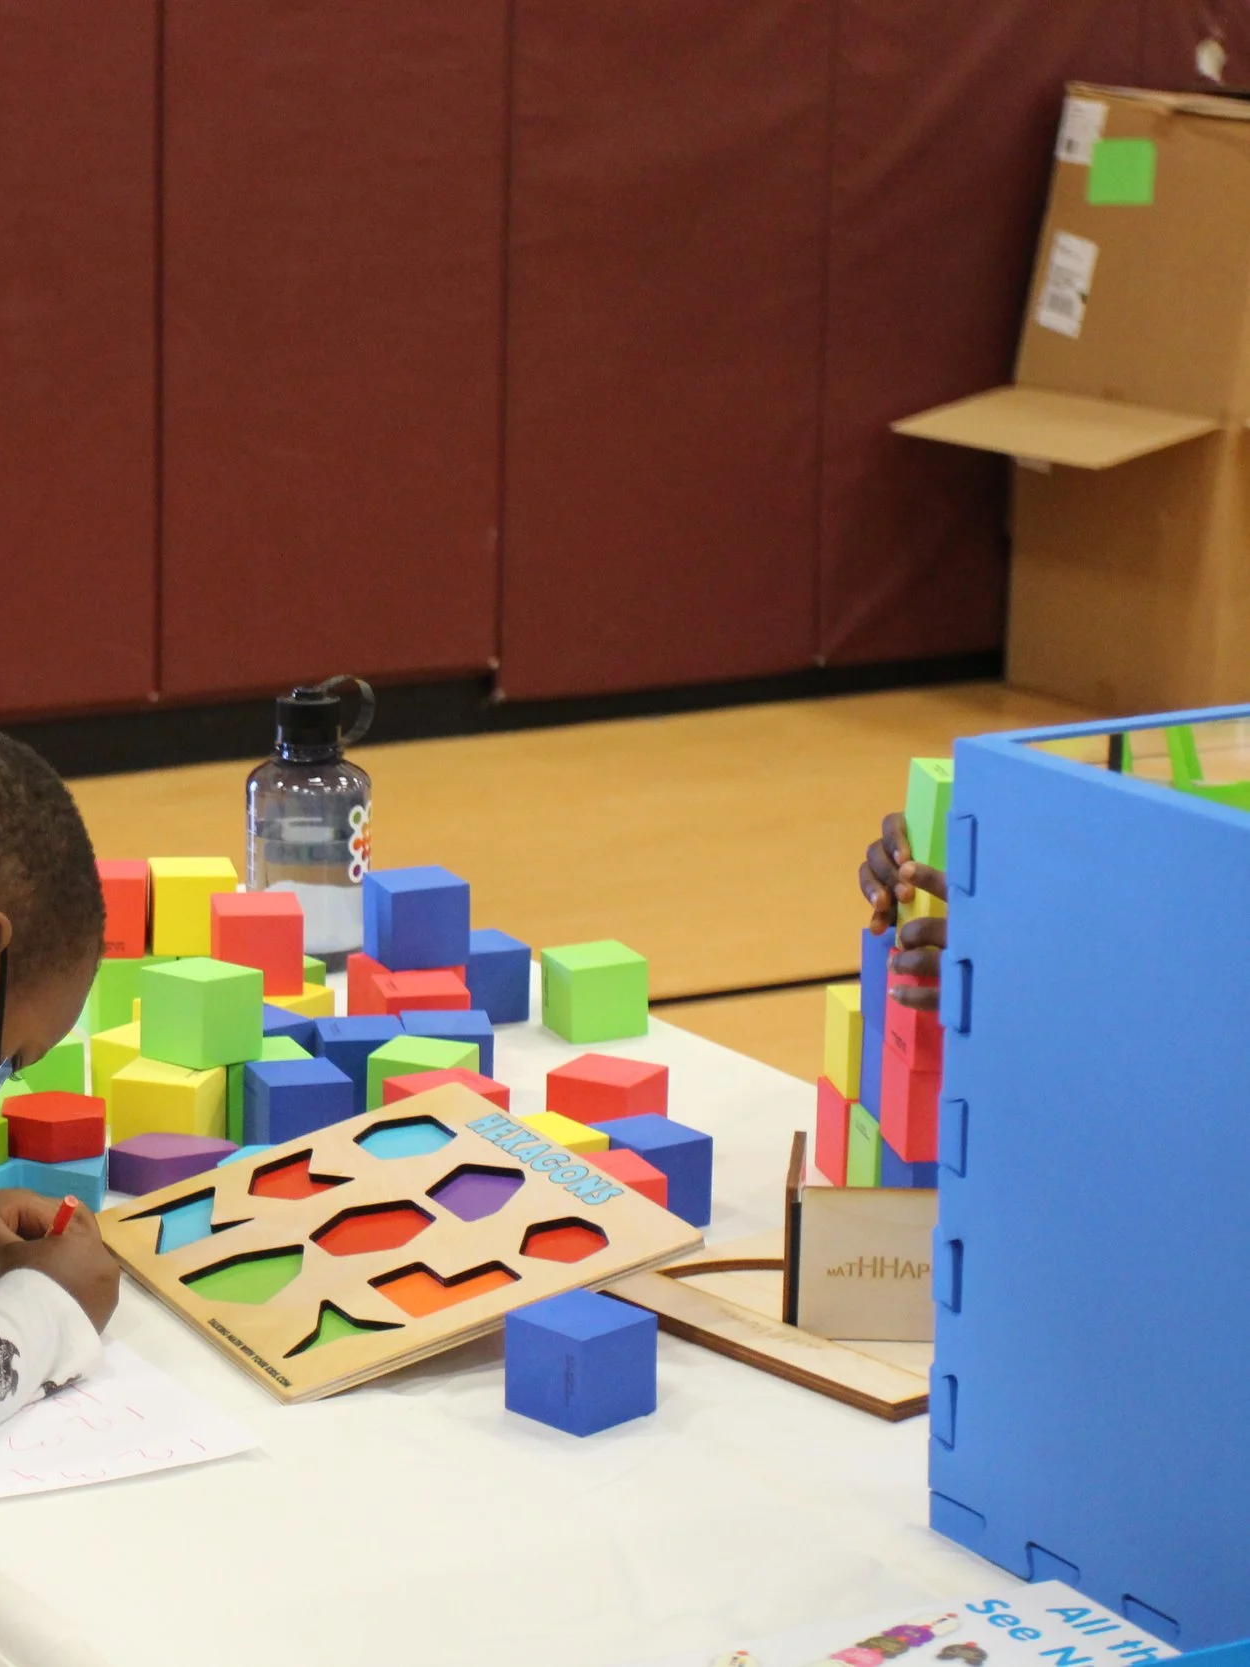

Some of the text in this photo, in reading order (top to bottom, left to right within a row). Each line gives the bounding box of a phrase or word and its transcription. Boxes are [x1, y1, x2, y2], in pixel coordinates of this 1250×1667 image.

[465, 1112, 625, 1206] HEXAGONS
[965, 1599, 1041, 1641] See
[1046, 1607, 1158, 1666] All th
